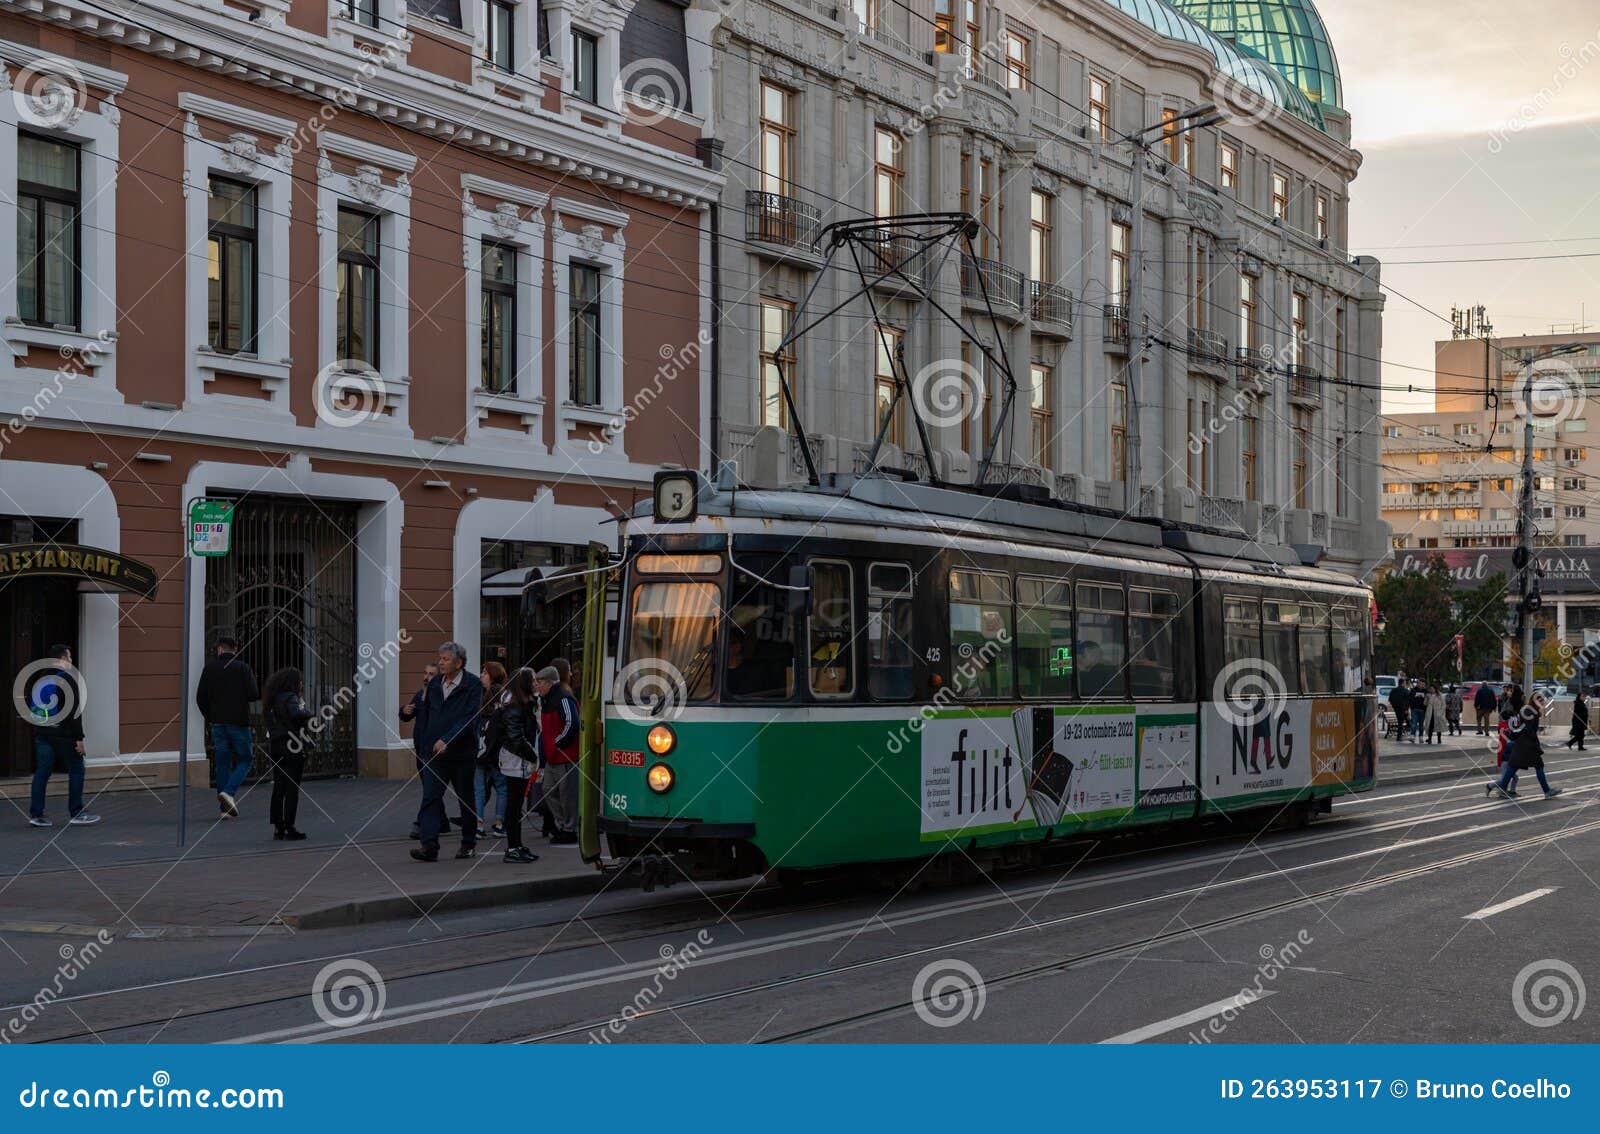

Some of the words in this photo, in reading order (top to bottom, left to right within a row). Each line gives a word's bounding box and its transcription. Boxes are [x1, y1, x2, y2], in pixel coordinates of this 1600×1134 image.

[672, 493, 682, 511] 3
[0, 550, 121, 577] RESTAURANT
[1533, 557, 1591, 572] MAIA
[926, 647, 941, 662] 425
[1063, 723, 1083, 740] 19-23
[1083, 721, 1117, 739] octombrie
[1117, 721, 1133, 737] 2022
[951, 728, 1012, 815] filit
[609, 793, 628, 810] 425
